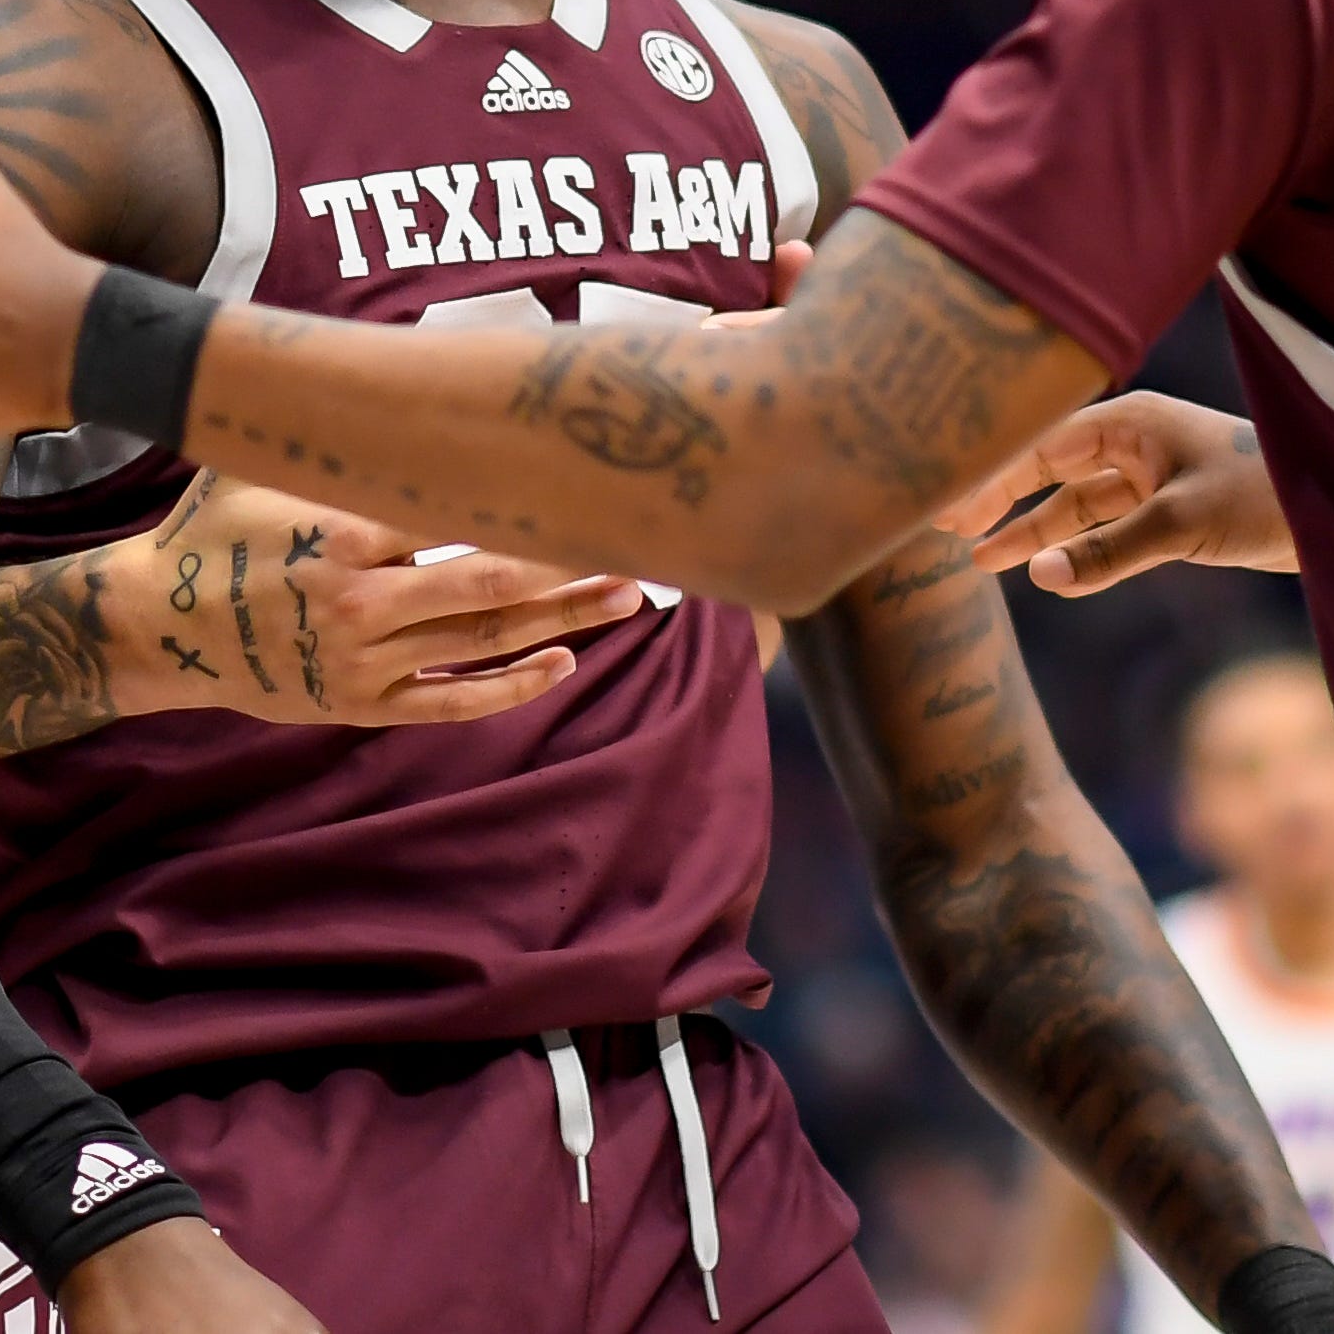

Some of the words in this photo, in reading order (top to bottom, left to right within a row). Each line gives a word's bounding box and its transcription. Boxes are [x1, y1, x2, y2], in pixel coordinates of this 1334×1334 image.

[481, 86, 572, 114] adidas
[299, 154, 605, 280] TEXAS
[624, 151, 772, 263] A&M
[71, 1158, 166, 1214] adidas
